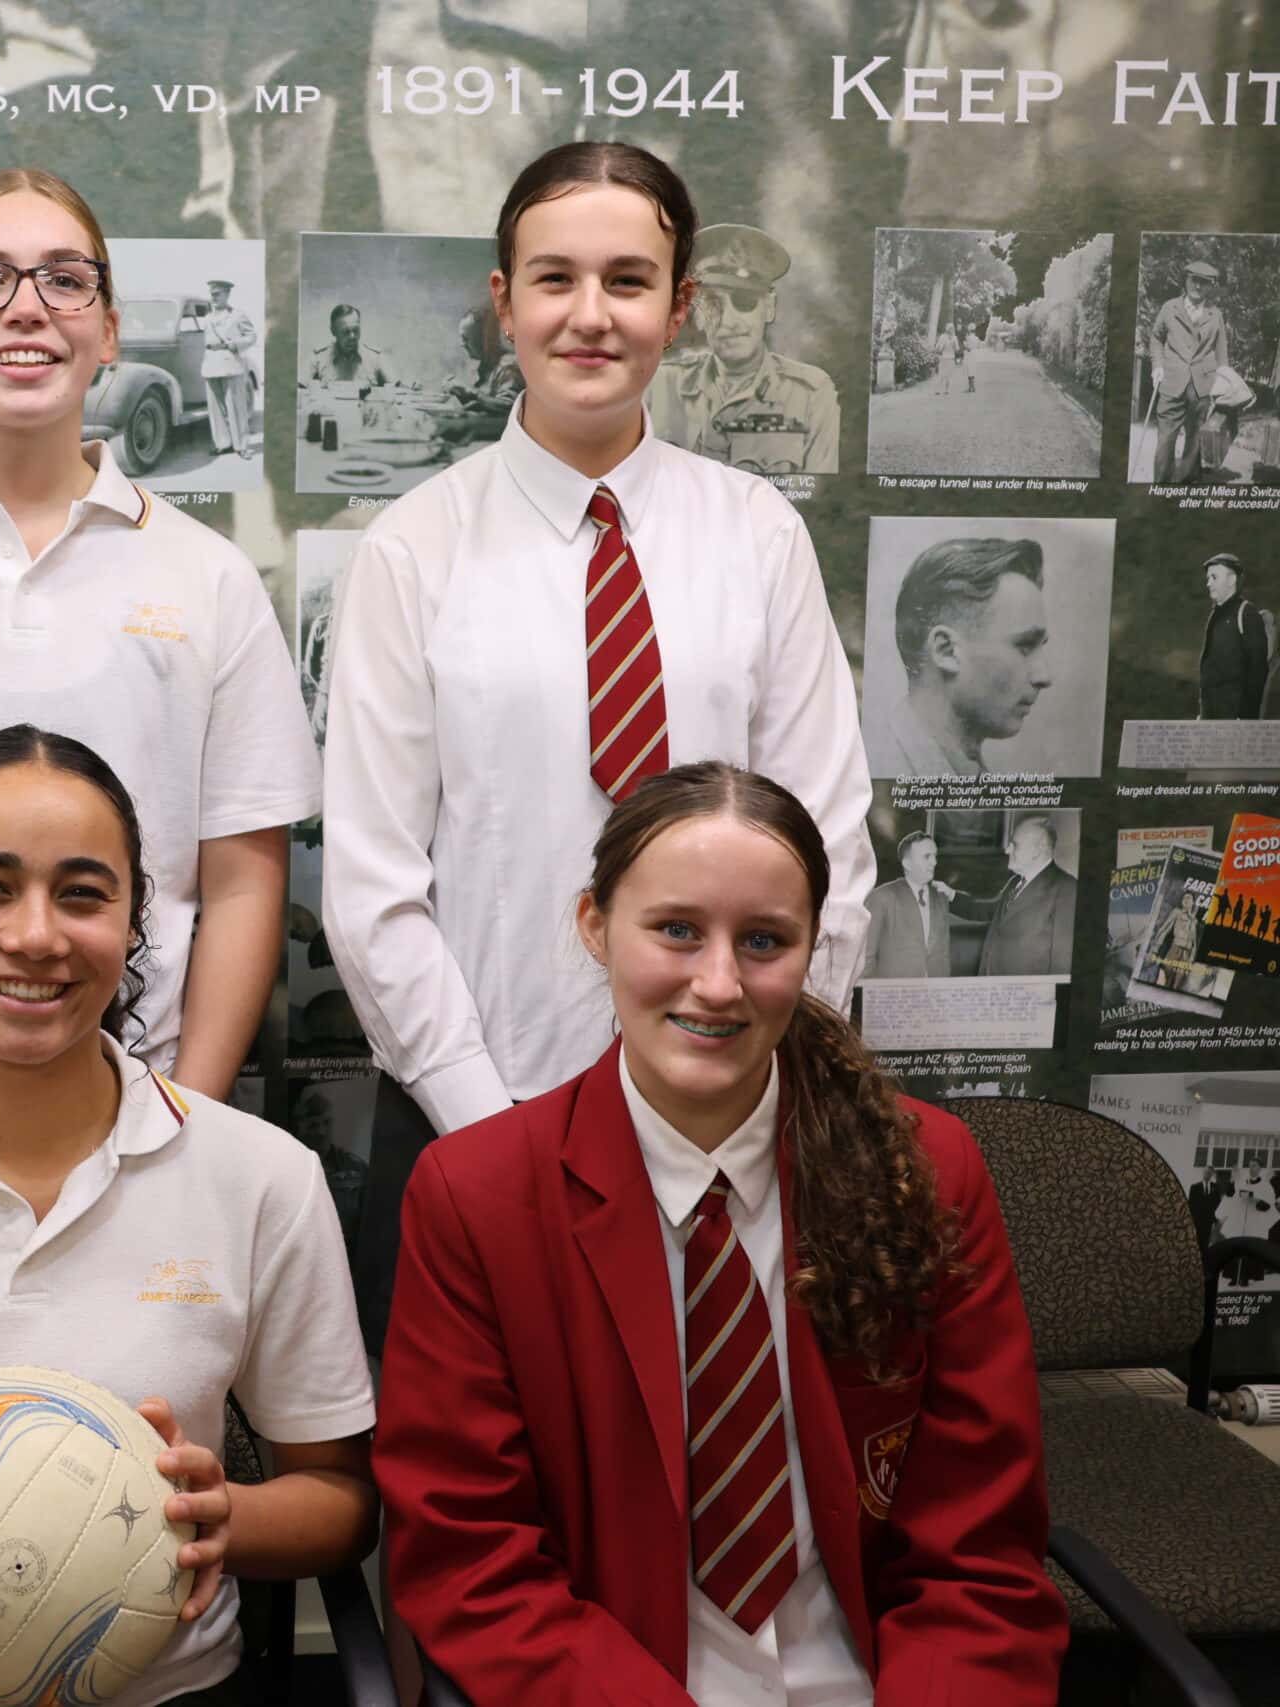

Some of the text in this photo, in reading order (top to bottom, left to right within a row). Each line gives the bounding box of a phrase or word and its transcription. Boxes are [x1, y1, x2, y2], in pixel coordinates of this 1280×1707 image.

[47, 83, 128, 120] MC,
[152, 84, 227, 120] VD,
[255, 85, 321, 113] MP
[830, 54, 1064, 124] KEEP
[1111, 58, 1280, 126] FAIT
[878, 476, 1089, 493] The escape tunnel was under this walkway
[1149, 485, 1188, 498] Hargest
[1190, 485, 1210, 496] and
[1211, 486, 1236, 496] Miles
[1239, 486, 1248, 496] in
[191, 493, 219, 504] 1941
[348, 496, 393, 508] Enjoyin
[1179, 497, 1280, 509] after their successful
[896, 773, 939, 785] Georges
[891, 786, 907, 796] the
[909, 786, 944, 796] French
[989, 785, 1011, 795] who
[1012, 784, 1064, 795] conducted
[1116, 785, 1153, 798] Hargest
[1154, 784, 1192, 796] dressed
[1192, 786, 1205, 796] as
[1214, 784, 1246, 795] French
[1247, 784, 1279, 797] railway
[893, 794, 1062, 810] Hargest to safety from Switzerland
[1119, 832, 1142, 842] THE
[1233, 836, 1280, 854] GOOD
[1110, 881, 1156, 900] CAMPO
[1115, 1028, 1137, 1039] 1944
[1140, 1027, 1163, 1039] book
[1165, 1027, 1214, 1040] (published
[1216, 1026, 1242, 1039] 1945)
[1244, 1025, 1257, 1038] by
[1094, 1035, 1276, 1051] relating to his odyssey from Florence to
[874, 1052, 1026, 1067] Hargest in NZ High Commission
[907, 1064, 929, 1076] after
[931, 1064, 946, 1075] his
[948, 1063, 977, 1075] return
[979, 1062, 1002, 1074] from
[1004, 1061, 1032, 1075] Spain
[1091, 1092, 1193, 1117] JAMES HARGEST
[1137, 1121, 1183, 1135] SCHOOL
[1242, 1294, 1255, 1306] by
[1257, 1293, 1273, 1304] the
